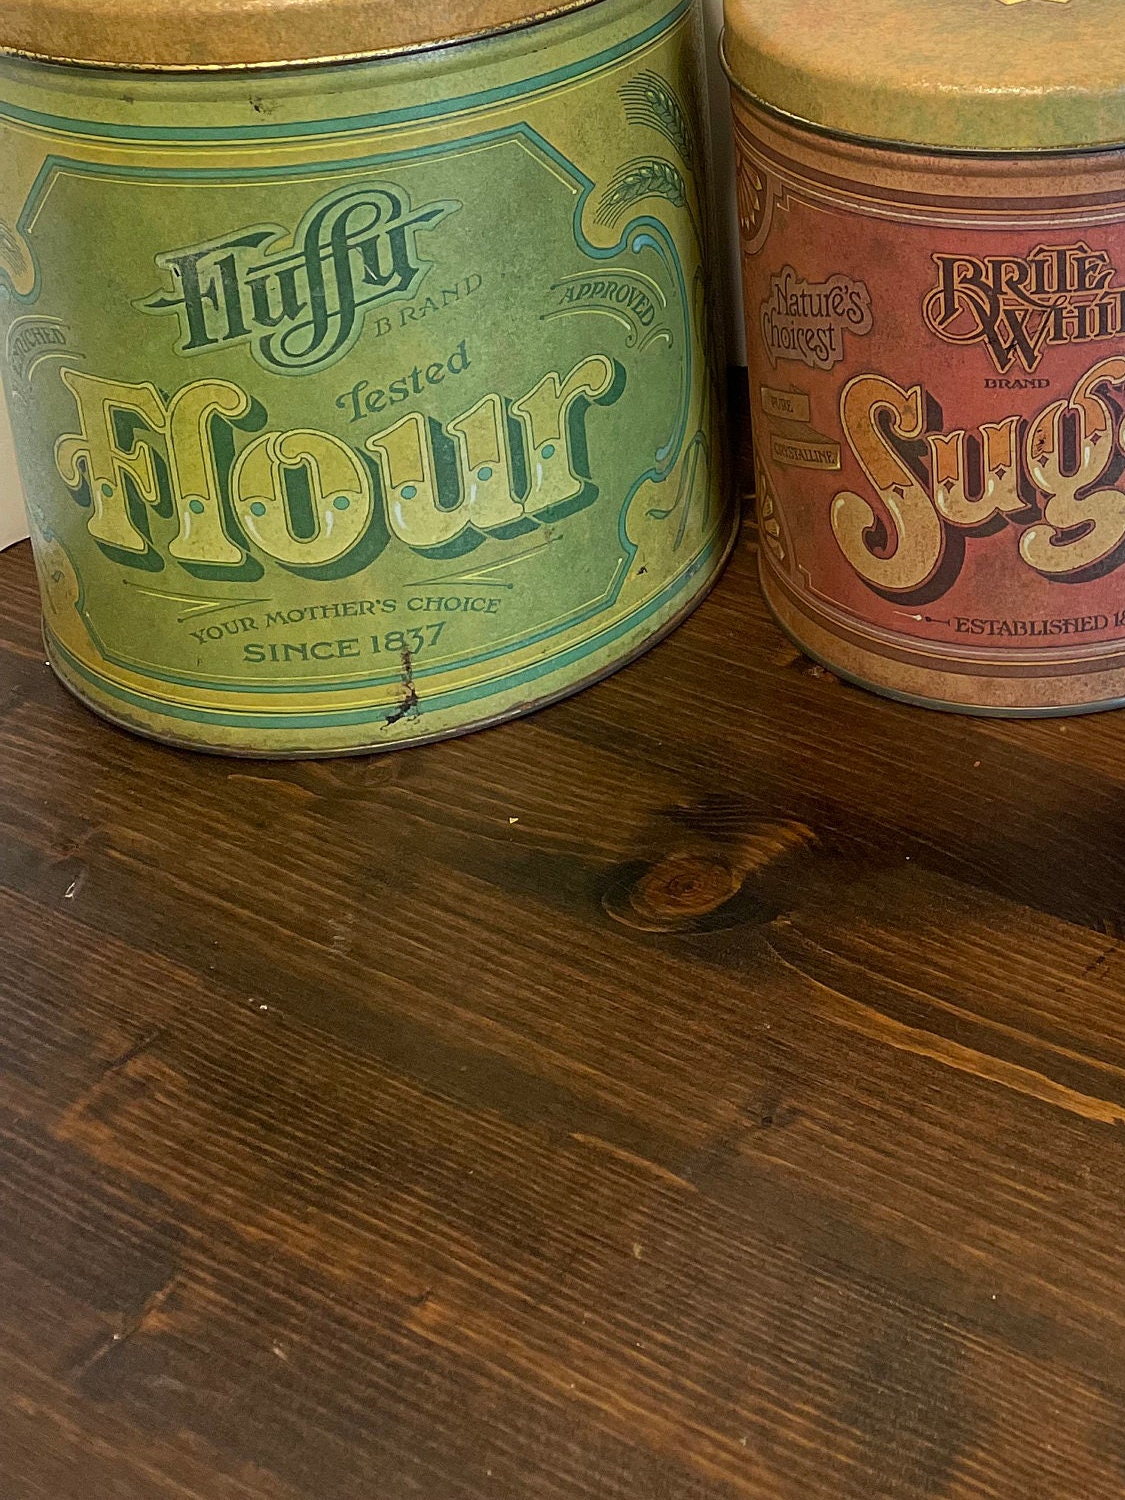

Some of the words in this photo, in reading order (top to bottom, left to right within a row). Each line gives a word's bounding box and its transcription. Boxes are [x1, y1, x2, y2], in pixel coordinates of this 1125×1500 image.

[140, 184, 452, 372] Fluffy
[559, 281, 655, 326] APPROVED
[775, 274, 864, 324] Nature's
[930, 246, 1108, 322] BRITE
[374, 274, 482, 338] BRAND
[762, 307, 836, 361] Choicest
[336, 340, 471, 422] Tested
[984, 378, 1050, 389] BRAND
[54, 355, 626, 580] Flour
[190, 617, 259, 645] YOUR
[265, 598, 397, 628] MOTHER'S
[406, 596, 501, 614] CHOICE
[243, 638, 360, 663] SINCE
[370, 621, 447, 655] 1837
[954, 614, 1108, 636] ESTABLISHED
